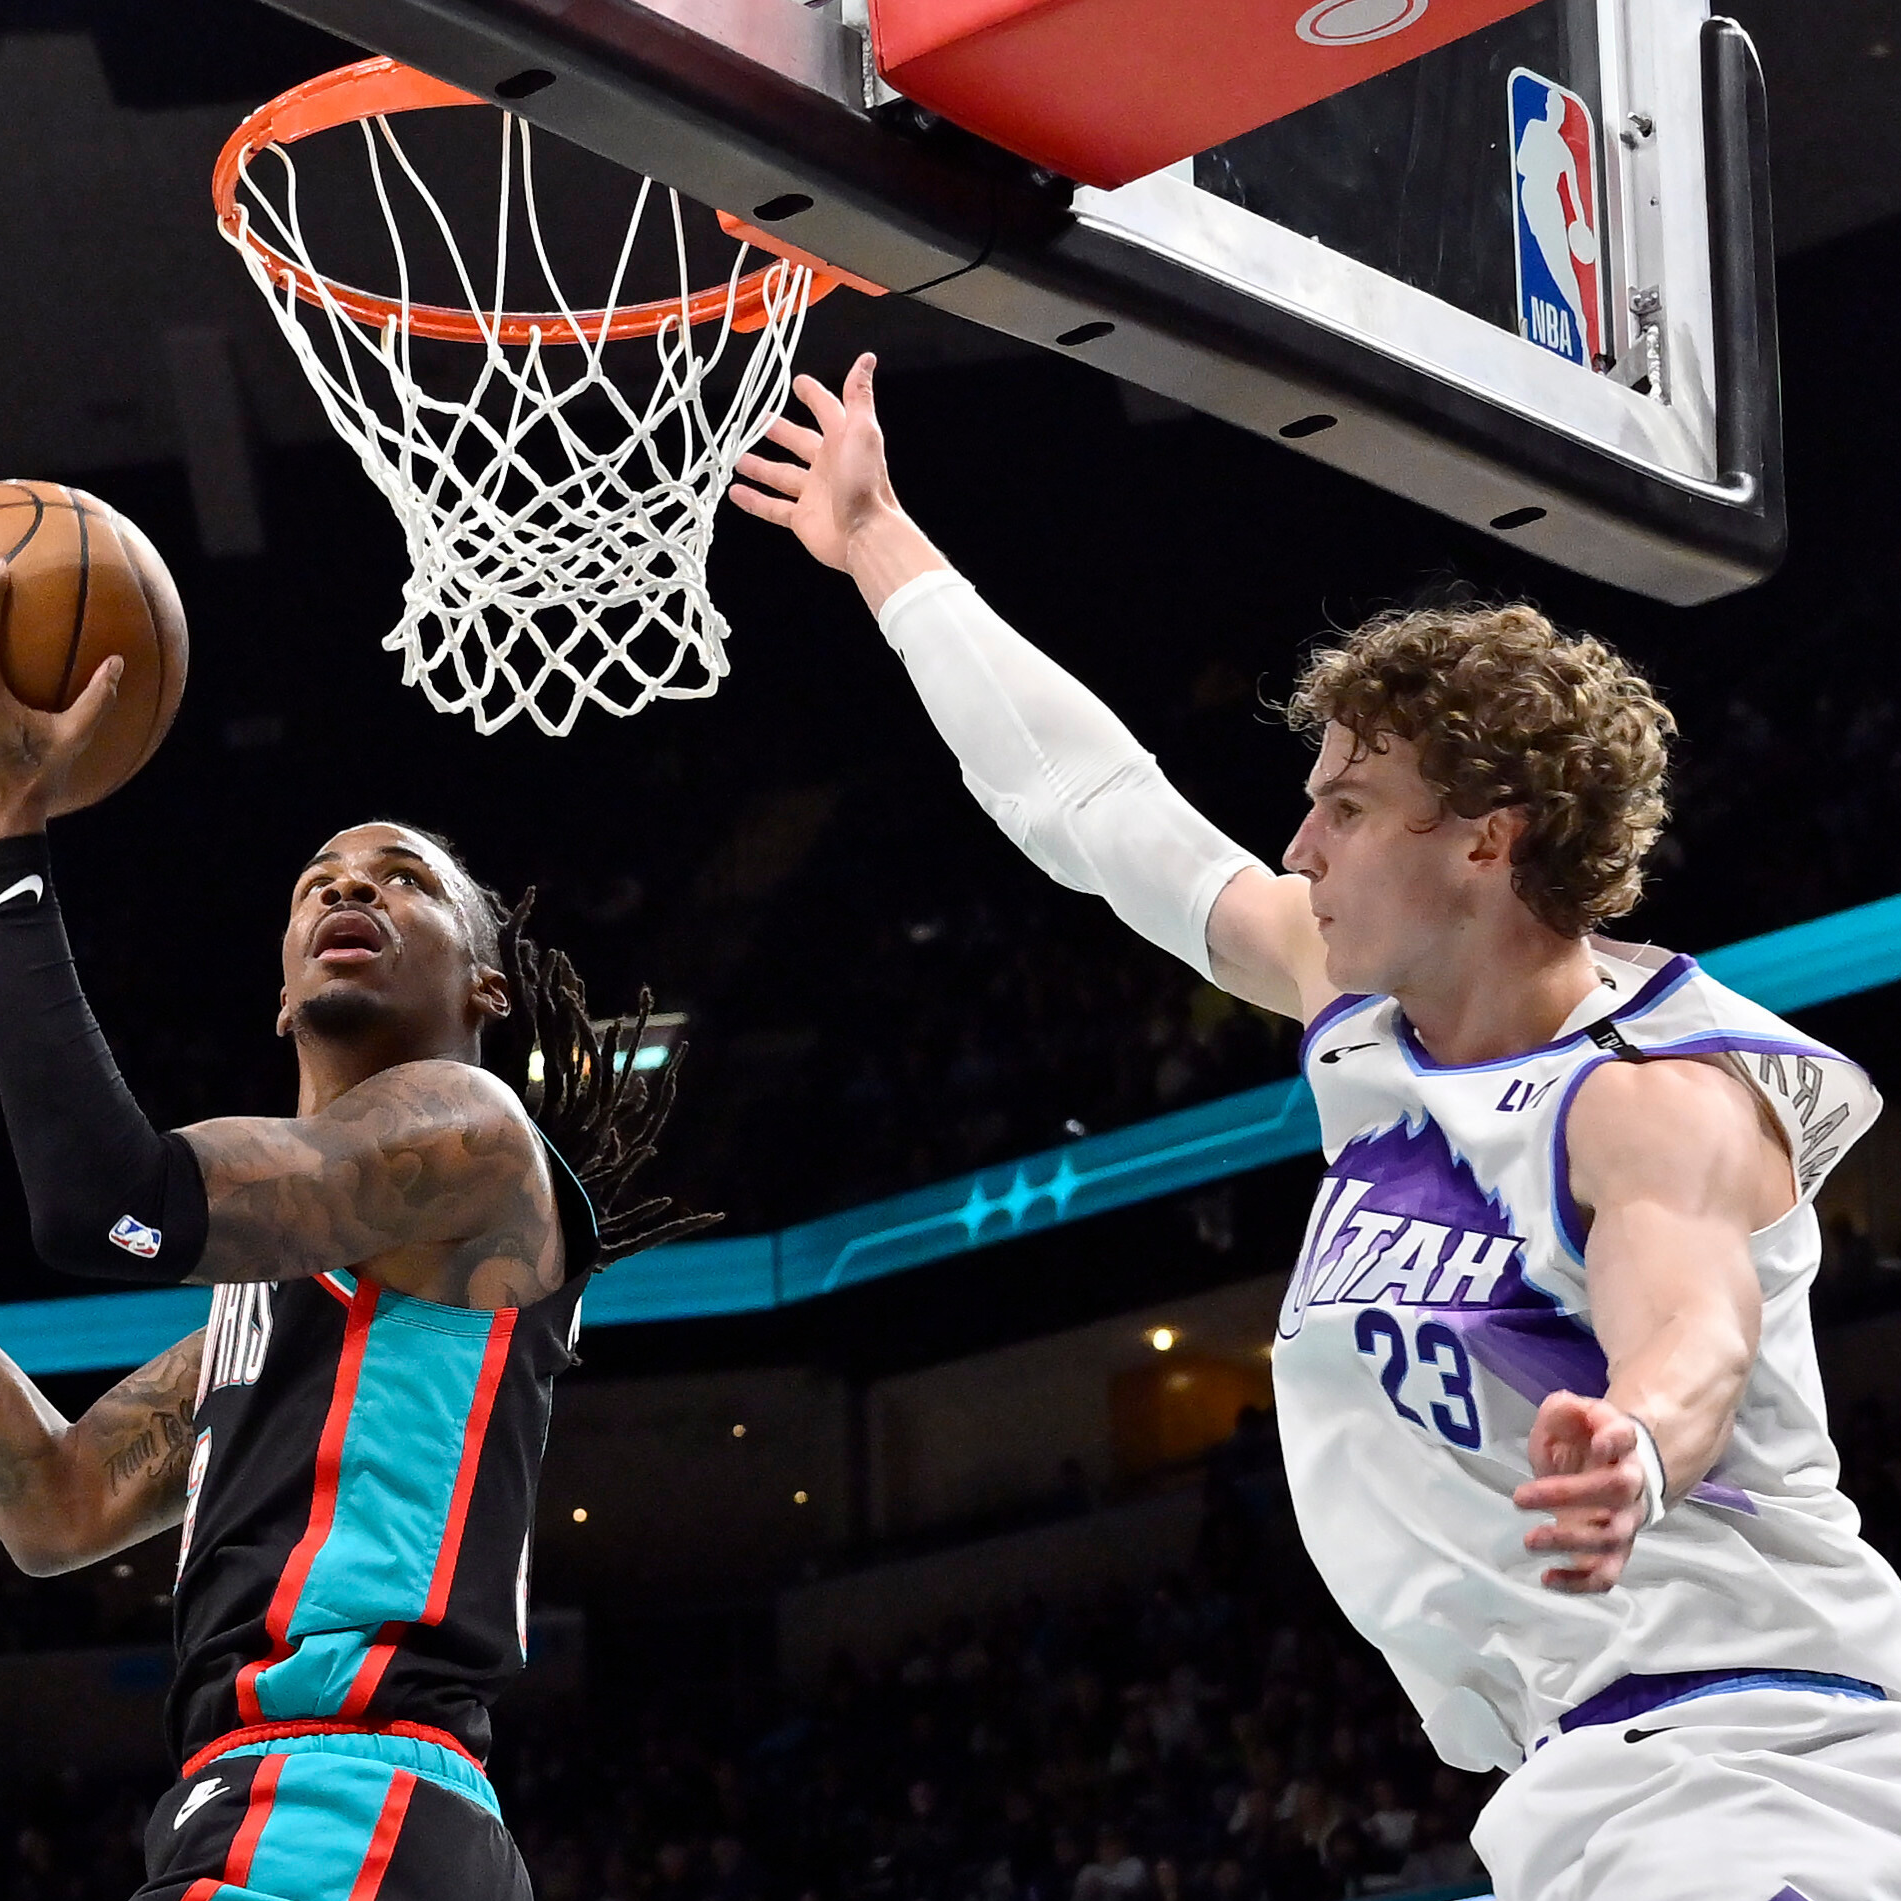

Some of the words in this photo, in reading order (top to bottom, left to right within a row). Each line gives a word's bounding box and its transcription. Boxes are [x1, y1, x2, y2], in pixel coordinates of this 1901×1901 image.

[1530, 296, 1574, 358] NBA
[1277, 1176, 1524, 1340] UTAH
[1355, 1308, 1481, 1451] 23
